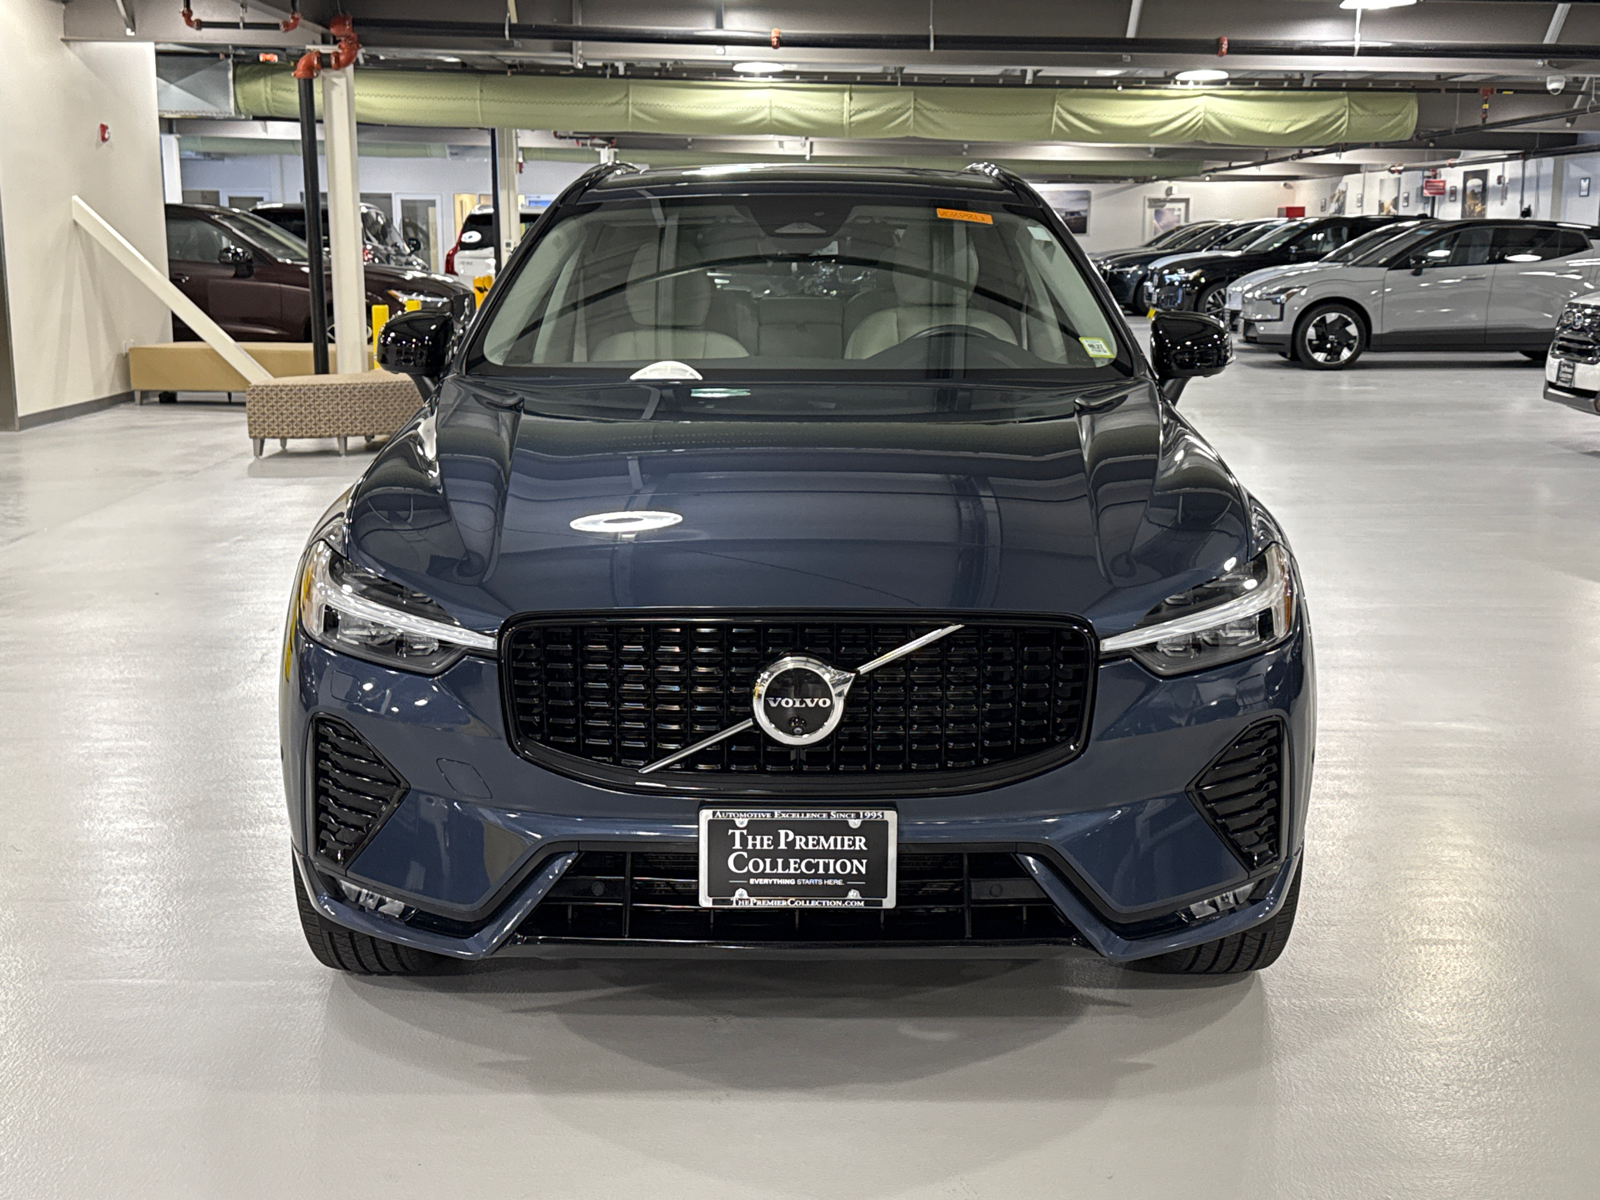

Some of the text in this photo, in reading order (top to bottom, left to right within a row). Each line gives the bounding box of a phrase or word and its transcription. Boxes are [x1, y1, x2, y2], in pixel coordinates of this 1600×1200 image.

[766, 697, 831, 708] VOLVO
[860, 811, 883, 819] 1995
[796, 878, 822, 886] STARTS
